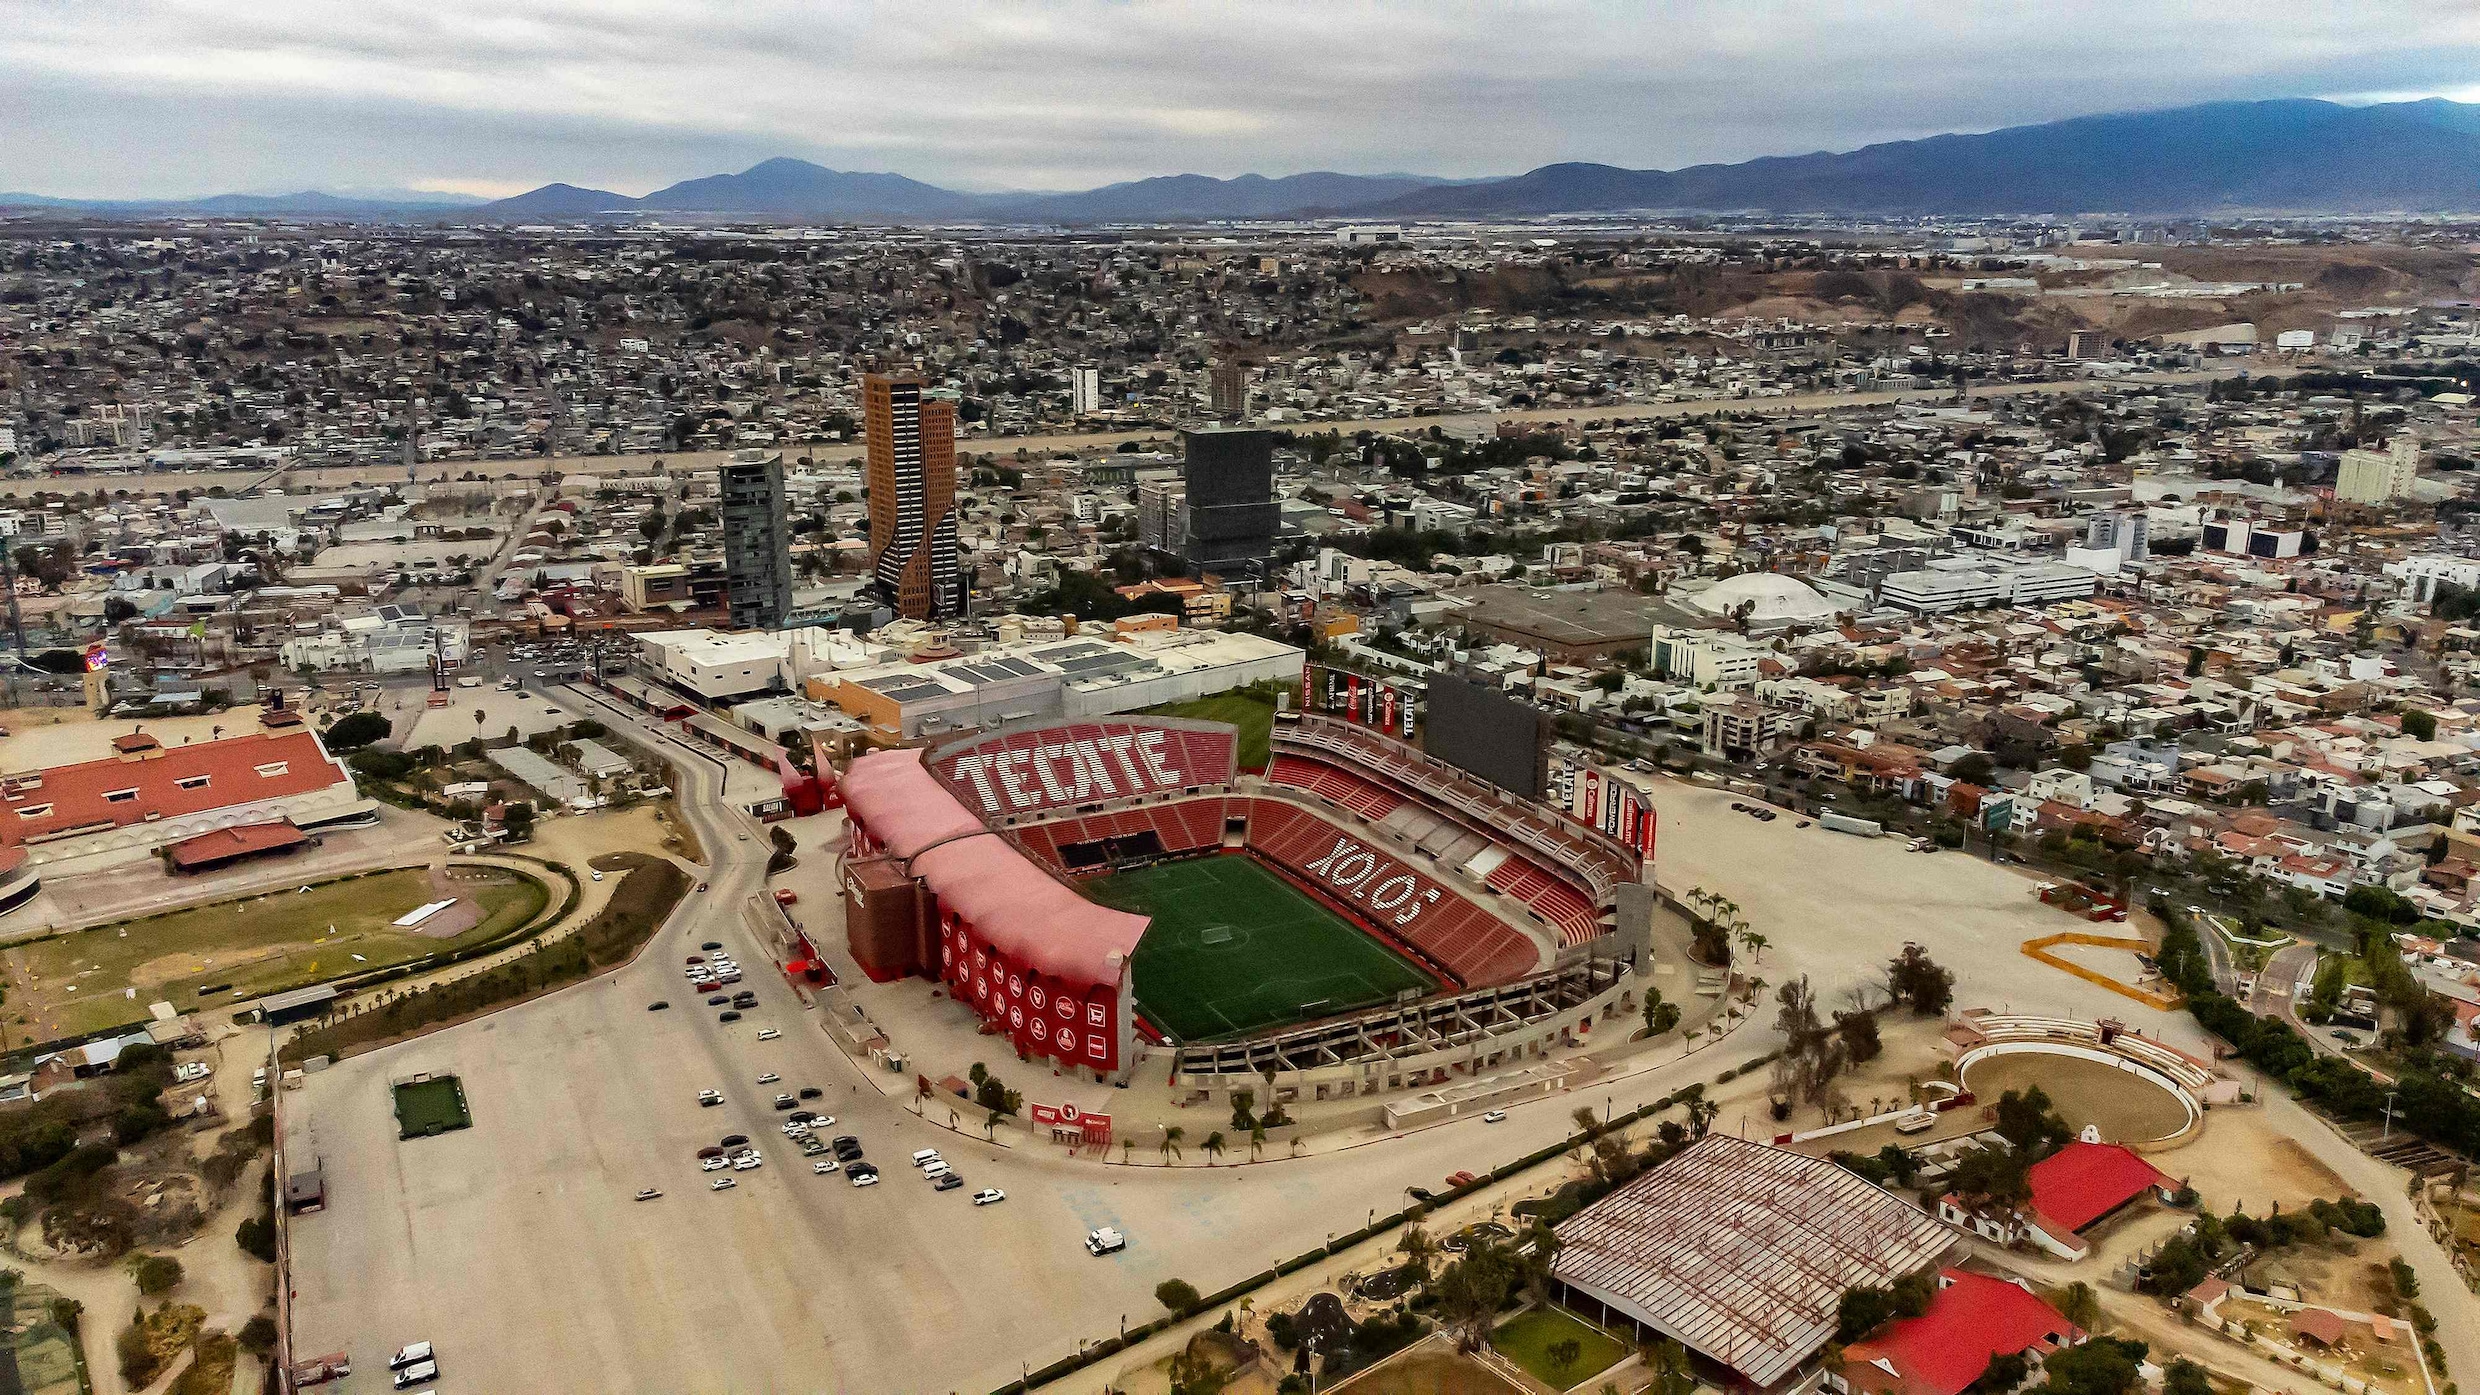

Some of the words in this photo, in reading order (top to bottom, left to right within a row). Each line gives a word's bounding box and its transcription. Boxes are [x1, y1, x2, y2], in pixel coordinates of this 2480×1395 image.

[1328, 673, 1336, 701] AFIRME
[1404, 695, 1414, 736] TECATE
[954, 731, 1180, 812] TECATE
[1563, 761, 1575, 807] TECATE
[1587, 790, 1595, 818] Calimax
[1607, 783, 1618, 835] POWERADE
[1625, 799, 1634, 844] caliente.mx
[1305, 837, 1442, 925] XOLOS
